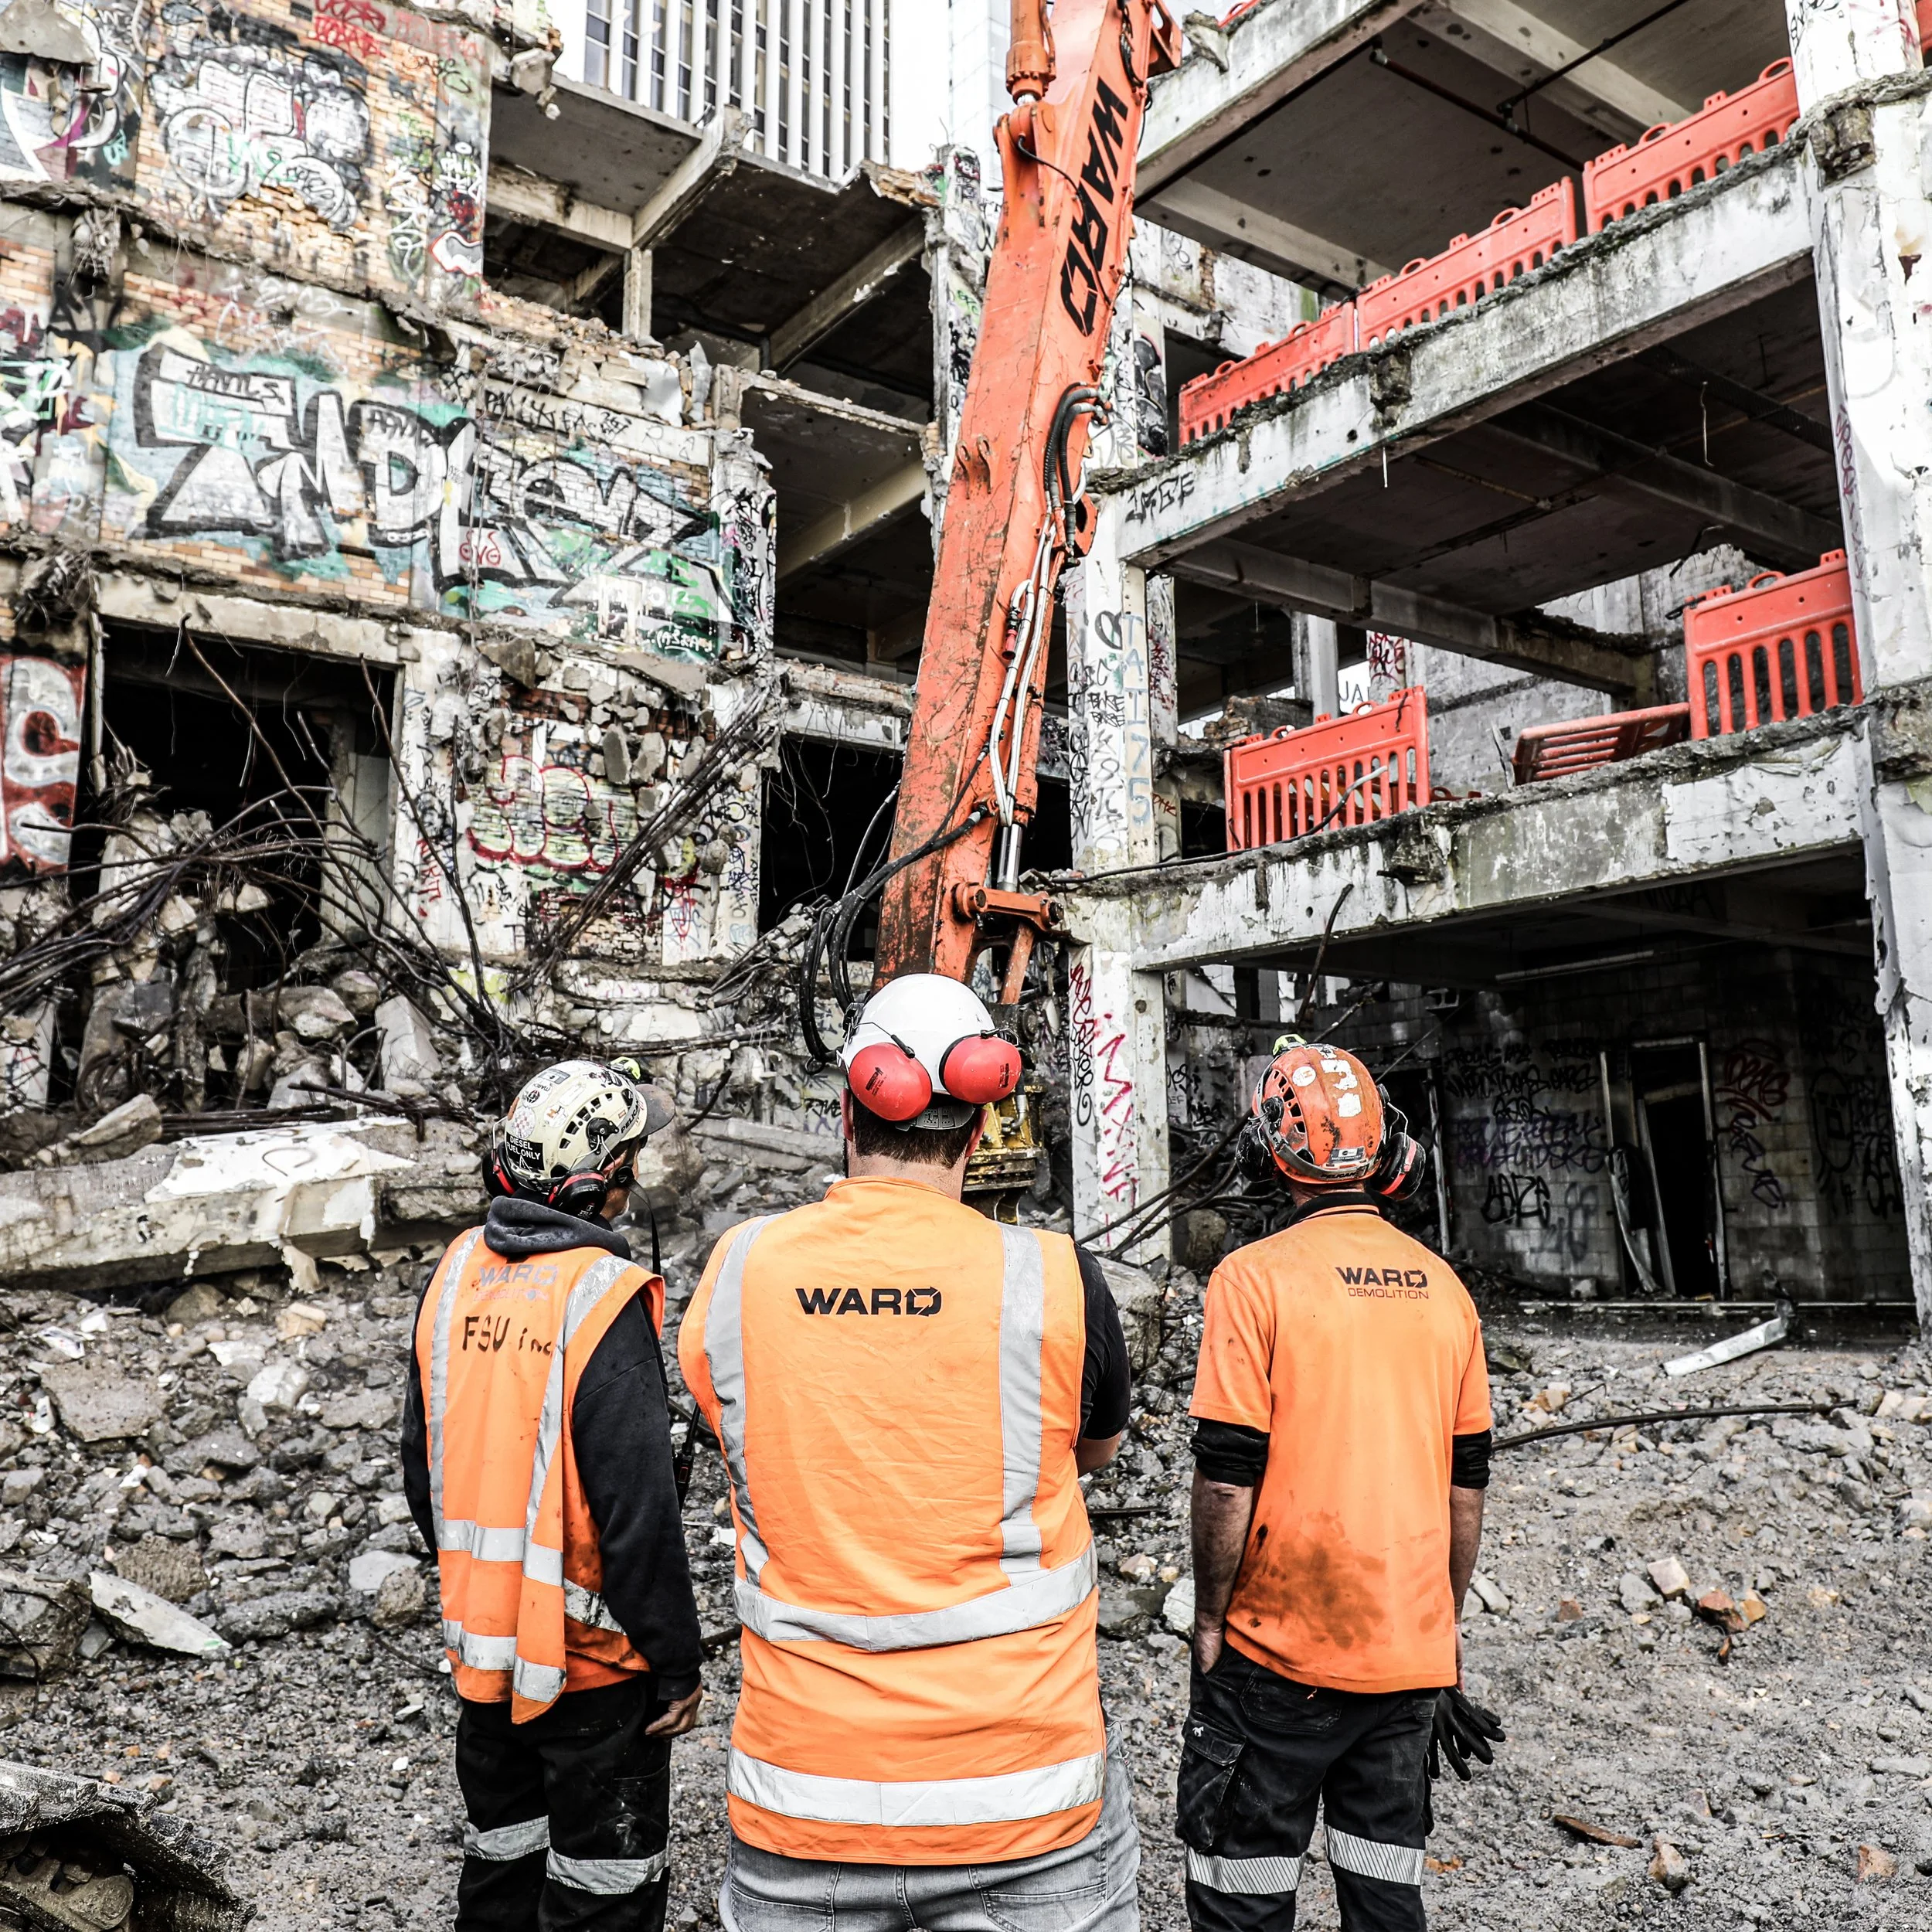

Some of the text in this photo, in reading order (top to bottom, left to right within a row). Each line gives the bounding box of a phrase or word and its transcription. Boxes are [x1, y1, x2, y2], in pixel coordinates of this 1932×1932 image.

[1060, 75, 1129, 337] WARD
[509, 1135, 533, 1151] DIESEL
[521, 1148, 541, 1161] ONLY
[1321, 1171, 1357, 1179] PELICAN
[479, 1264, 560, 1288] WARD
[1335, 1267, 1429, 1289] WARD
[795, 1286, 942, 1318] WARD
[1348, 1287, 1430, 1300] DEMOLITION
[462, 1315, 511, 1353] FSU
